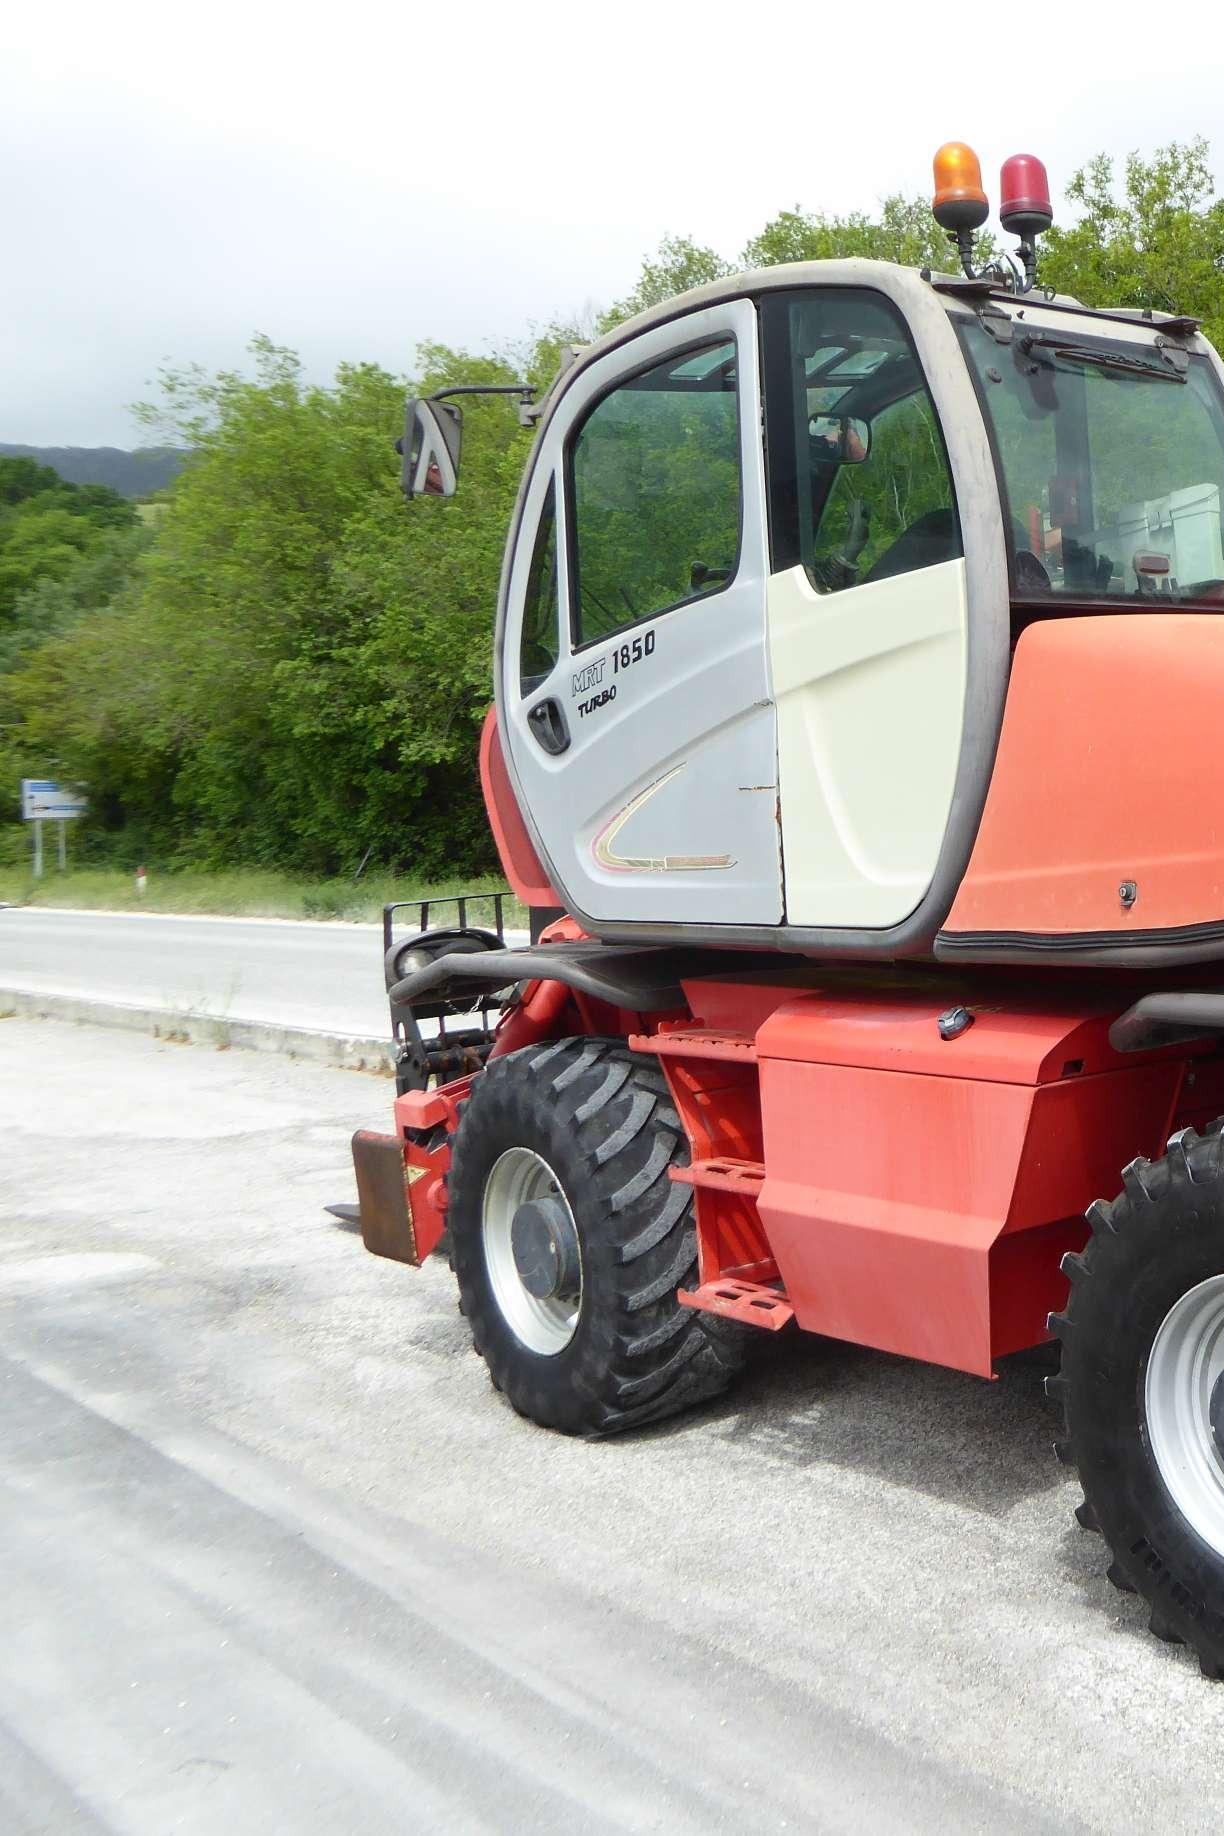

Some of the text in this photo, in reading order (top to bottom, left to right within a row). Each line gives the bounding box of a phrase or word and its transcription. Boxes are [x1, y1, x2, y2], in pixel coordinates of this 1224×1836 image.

[571, 630, 656, 697] MRT 1850
[577, 684, 617, 718] TURBO
